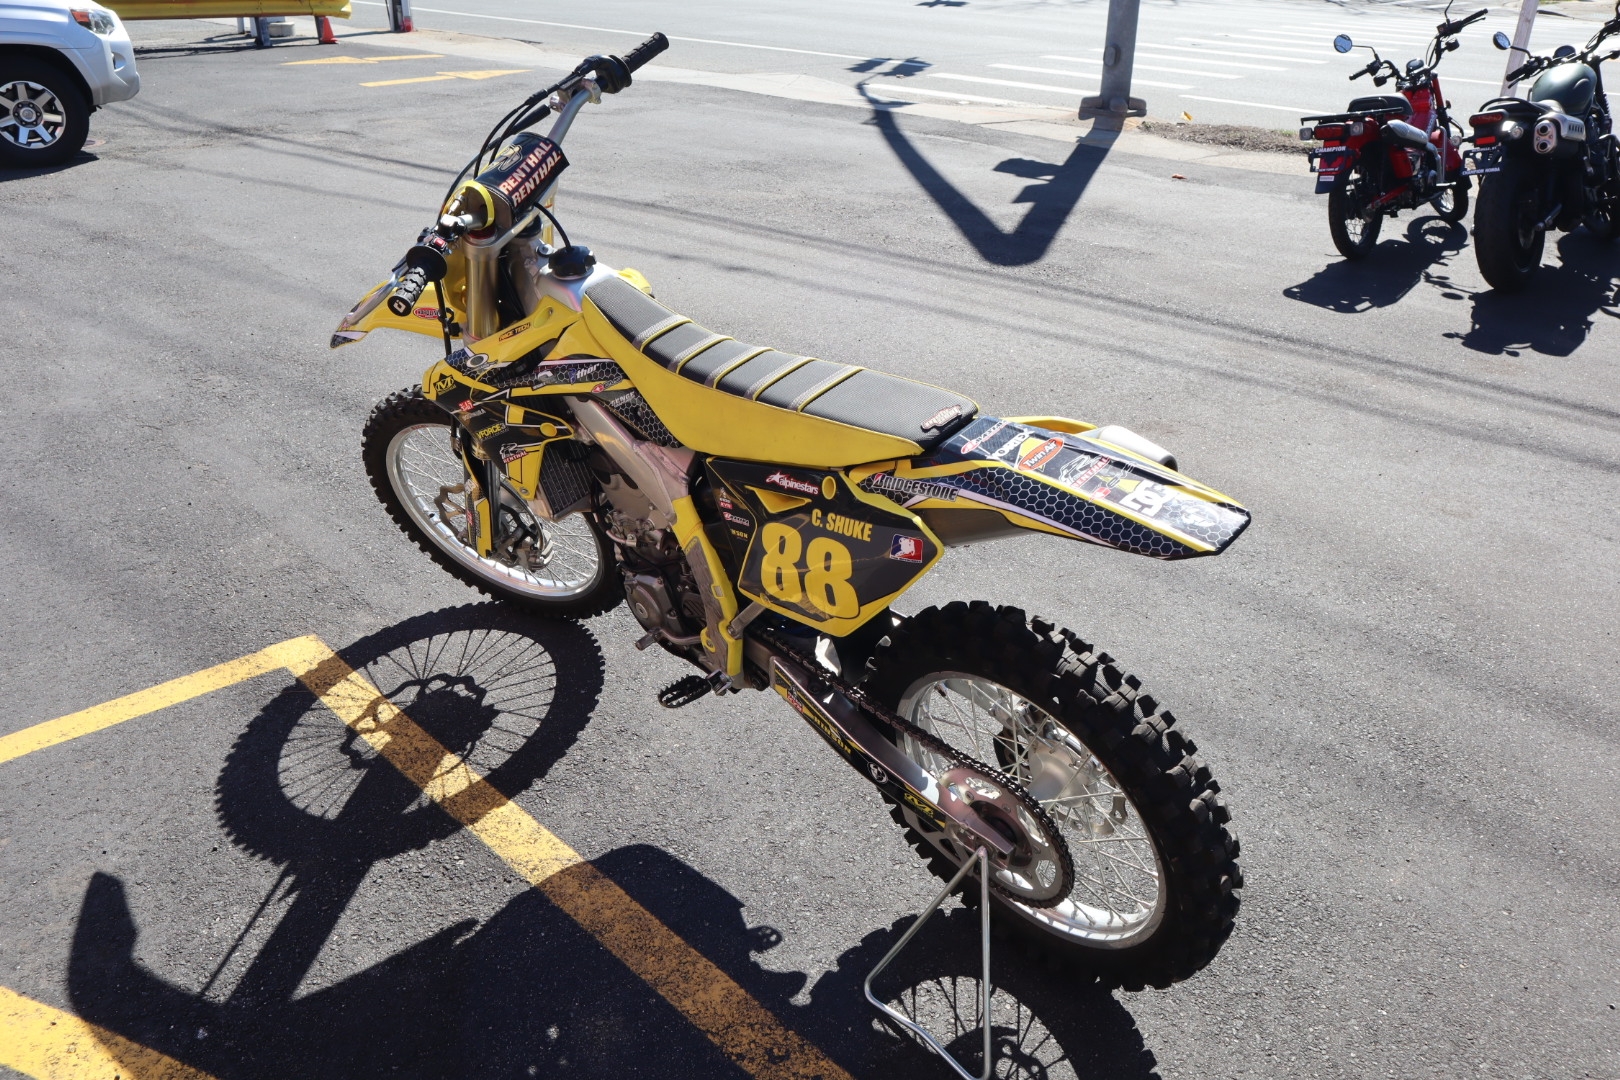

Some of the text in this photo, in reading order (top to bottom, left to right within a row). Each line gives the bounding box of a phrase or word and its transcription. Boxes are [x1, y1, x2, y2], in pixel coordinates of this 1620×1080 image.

[499, 141, 553, 195] RENTHAL
[512, 150, 562, 208] RENTHAL
[576, 363, 600, 379] thor
[503, 450, 529, 463] RENTHAL
[1023, 440, 1058, 468] Twin Air
[778, 476, 819, 495] alpinestars
[872, 473, 959, 501] BRIDGESTONE
[811, 508, 874, 543] C. SHUKE
[761, 522, 861, 620] 88
